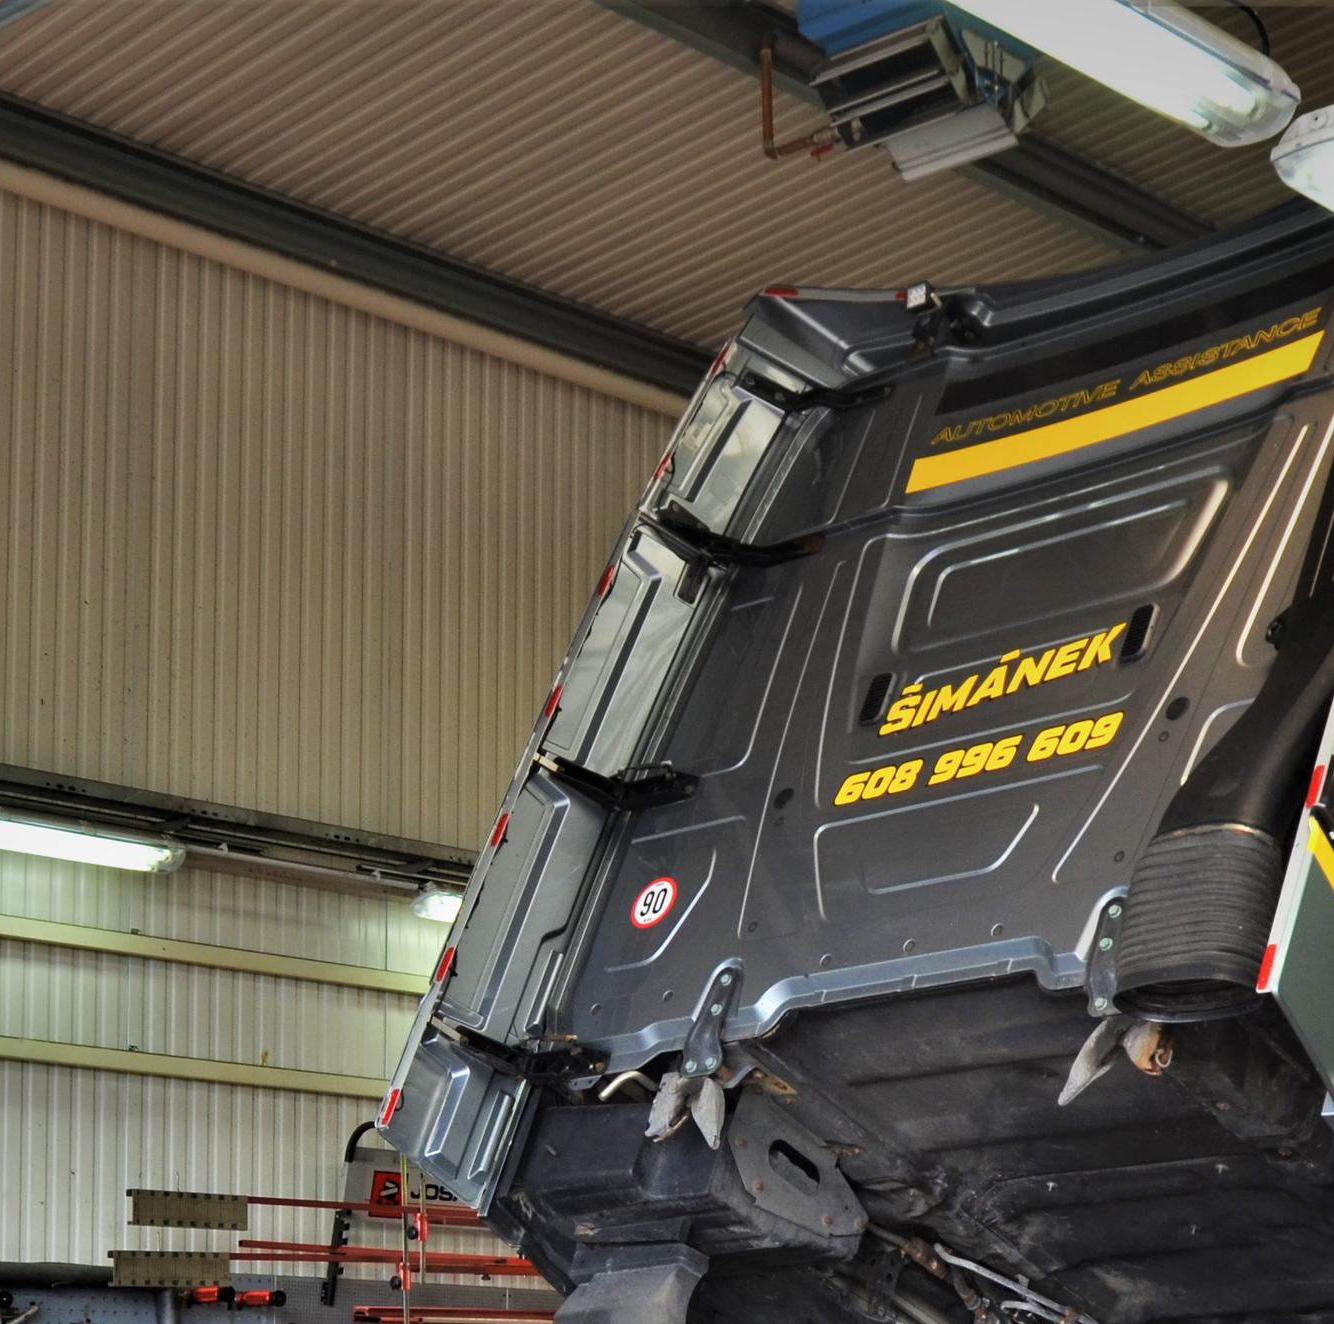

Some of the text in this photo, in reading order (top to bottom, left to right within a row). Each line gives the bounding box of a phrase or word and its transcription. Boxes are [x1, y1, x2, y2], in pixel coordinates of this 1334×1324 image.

[930, 306, 1322, 446] AUTOMOTIVE ASSISTANCE
[834, 711, 1125, 806] 608 996 609
[639, 887, 668, 917] 90
[410, 1184, 458, 1201] JOS
